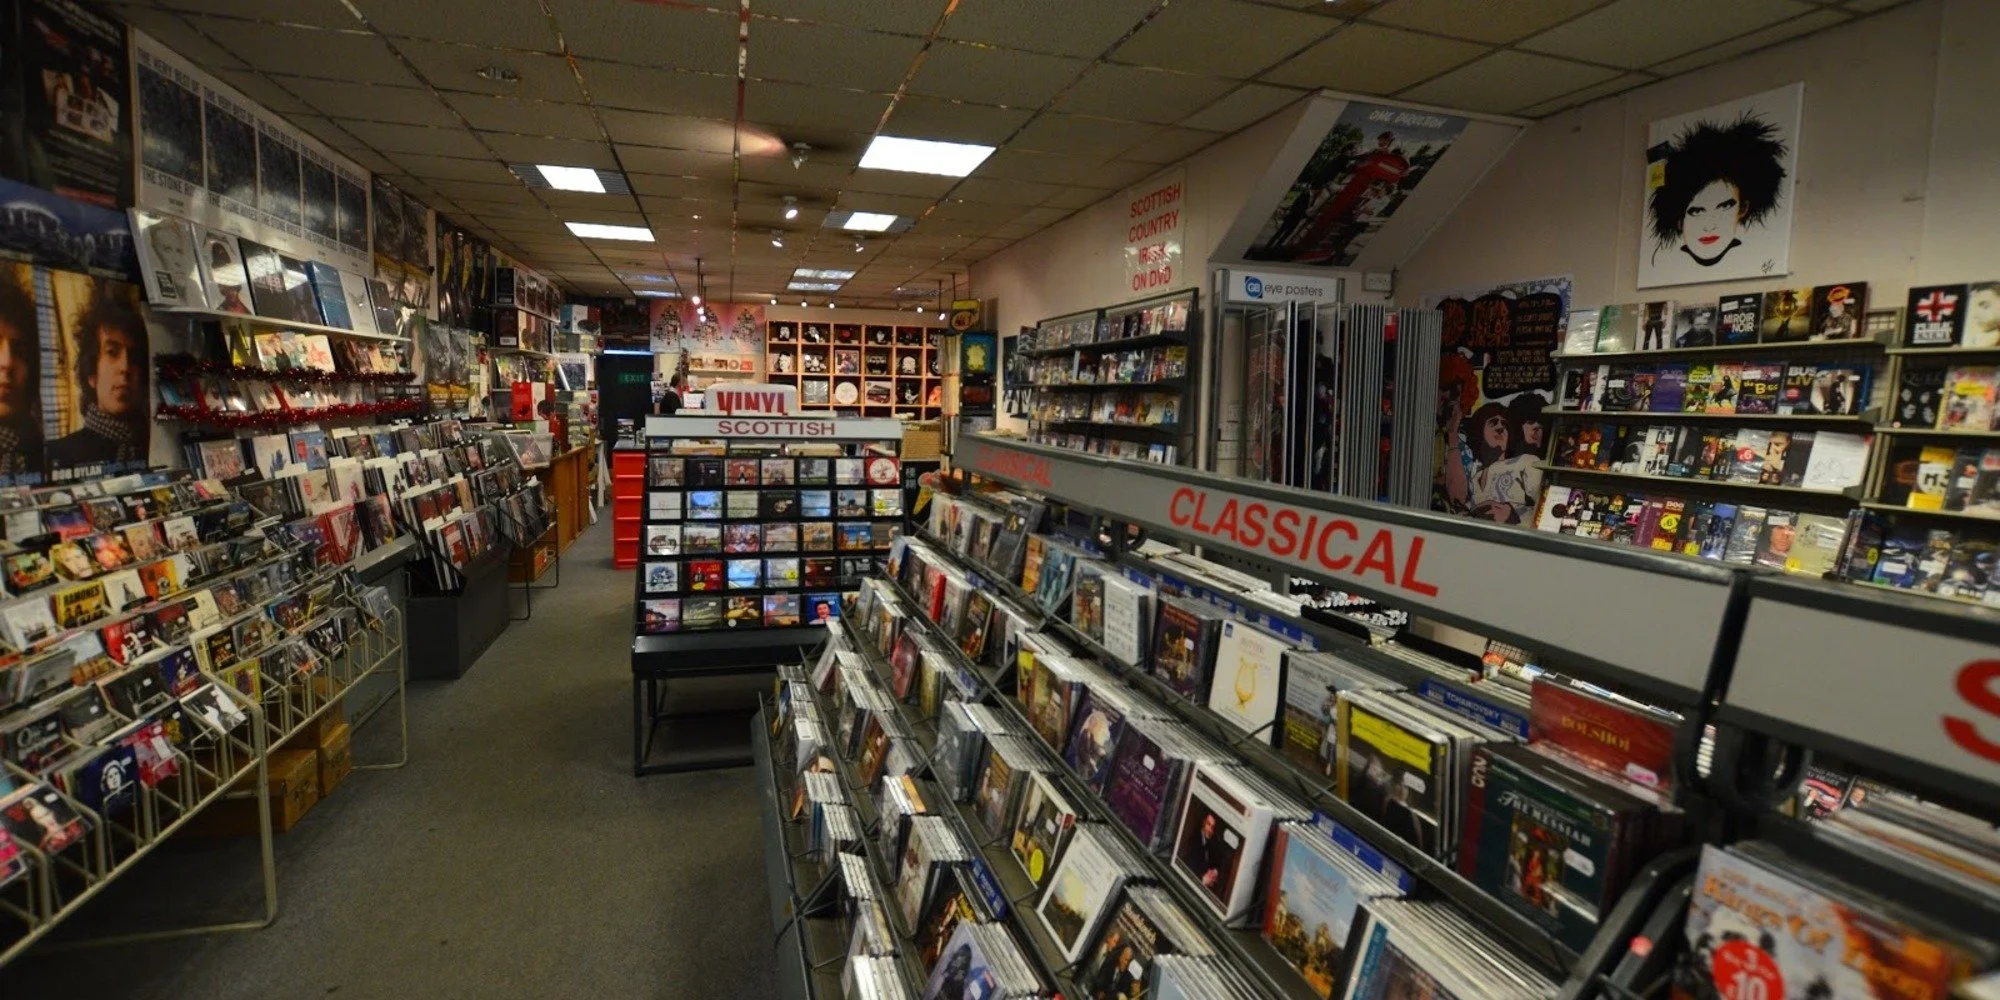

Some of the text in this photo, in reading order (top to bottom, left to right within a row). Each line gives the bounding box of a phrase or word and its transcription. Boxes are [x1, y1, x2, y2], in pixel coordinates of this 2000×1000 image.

[1369, 109, 1396, 122] ONE
[1130, 182, 1181, 218] SCOTTISH
[1129, 208, 1180, 243] COUNTRY
[1132, 265, 1171, 291] ON DVD
[1264, 284, 1323, 297] eye posters
[624, 374, 645, 382] EXIT
[716, 391, 788, 415] VINYL
[718, 420, 836, 436] SCOTTISH
[52, 468, 74, 482] BOB
[74, 464, 102, 479] DYLAN
[974, 445, 1054, 488] CLASSICAL
[1168, 486, 1440, 598] CLASSICAL
[63, 585, 100, 602] RAMONES
[1446, 690, 1501, 720] TCHAIKOVSKY
[1531, 808, 1592, 848] MESSIAH
